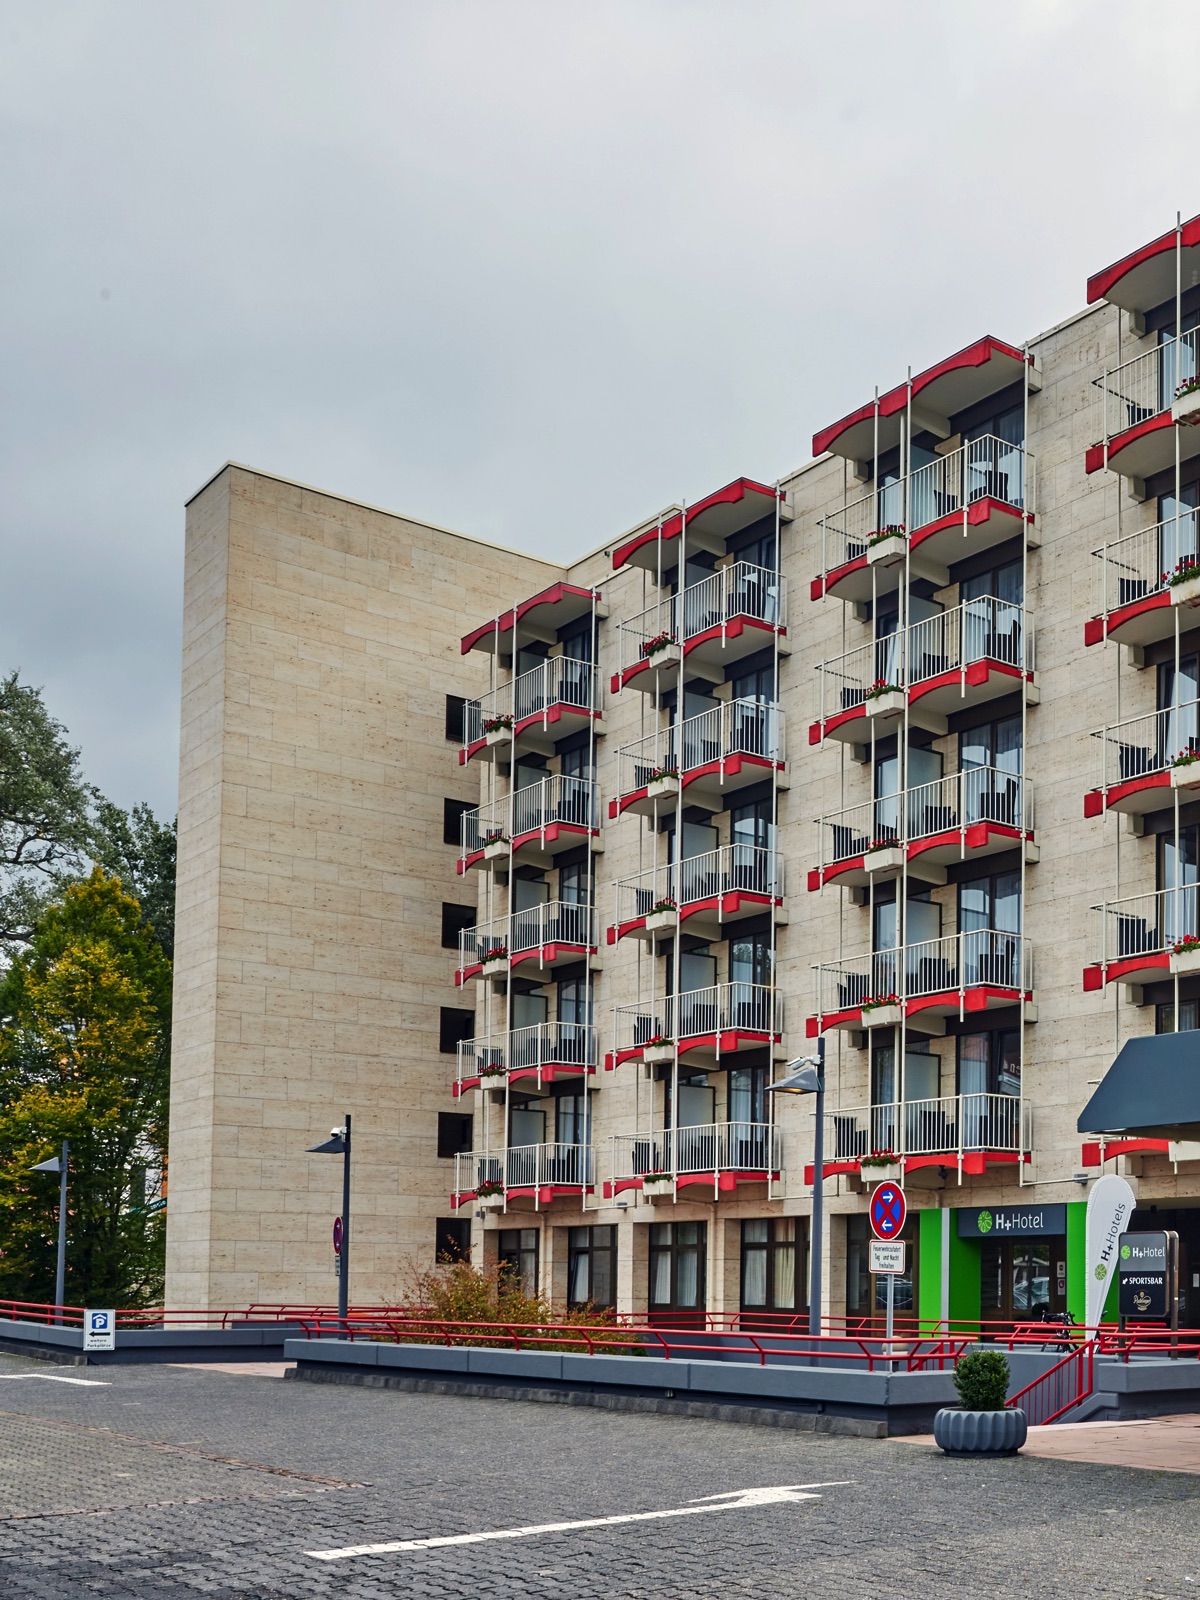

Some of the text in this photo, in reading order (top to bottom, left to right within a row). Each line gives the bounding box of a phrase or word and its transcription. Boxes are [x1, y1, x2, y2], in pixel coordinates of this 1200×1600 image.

[996, 1212, 1043, 1231] H+Hotel
[1100, 1203, 1126, 1262] H+Hotels
[1132, 1247, 1165, 1258] H+Hotel
[1129, 1277, 1163, 1285] SPORTSBAR
[95, 1318, 105, 1328] P
